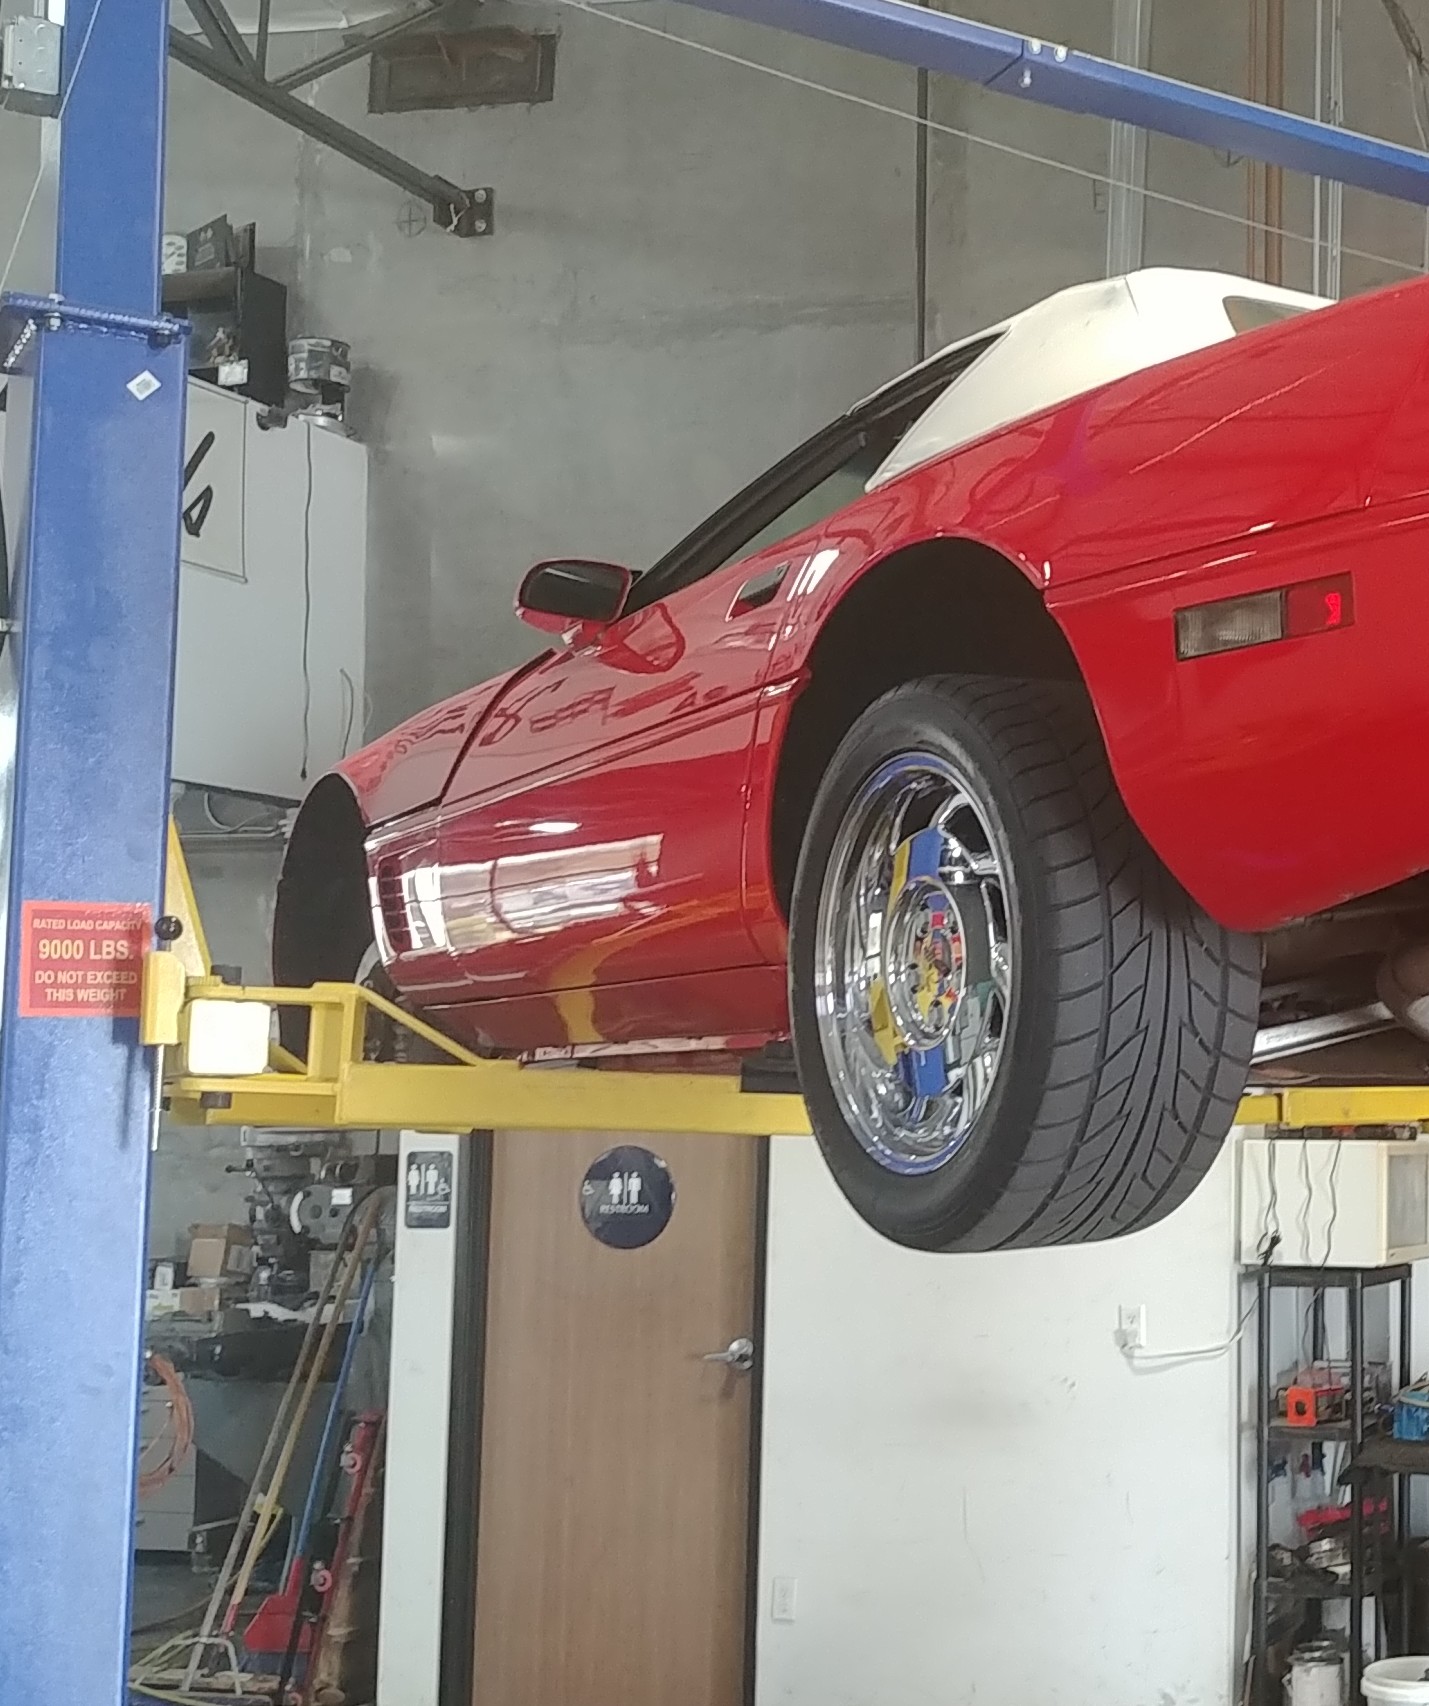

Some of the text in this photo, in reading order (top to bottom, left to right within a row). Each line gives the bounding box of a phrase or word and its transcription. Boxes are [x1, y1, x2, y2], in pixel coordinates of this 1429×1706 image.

[33, 918, 142, 931] RATED LOAD CAPACITY
[38, 939, 134, 960] 9000 LBS.
[34, 970, 138, 984] DO NOT EXCEED
[45, 988, 127, 1002] THIS WEIGHT
[599, 1203, 650, 1215] RESTROOM
